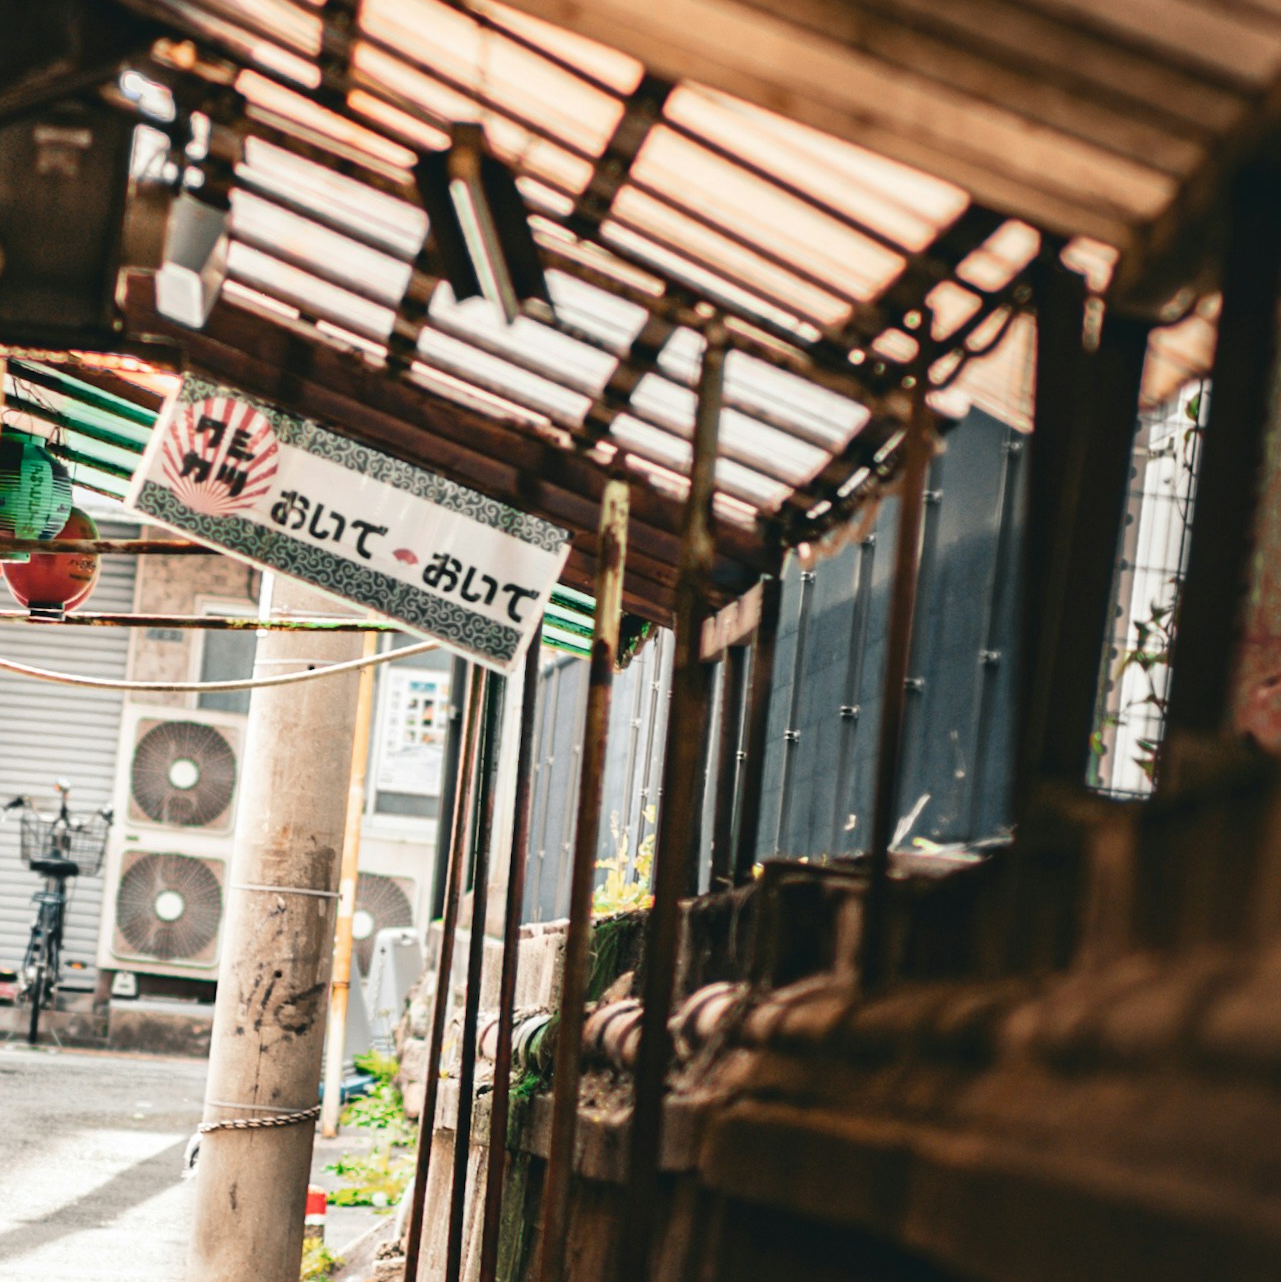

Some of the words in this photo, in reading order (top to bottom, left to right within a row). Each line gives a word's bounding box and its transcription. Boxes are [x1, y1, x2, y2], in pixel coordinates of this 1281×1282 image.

[270, 489, 389, 561] おいで
[422, 552, 541, 624] おいで
